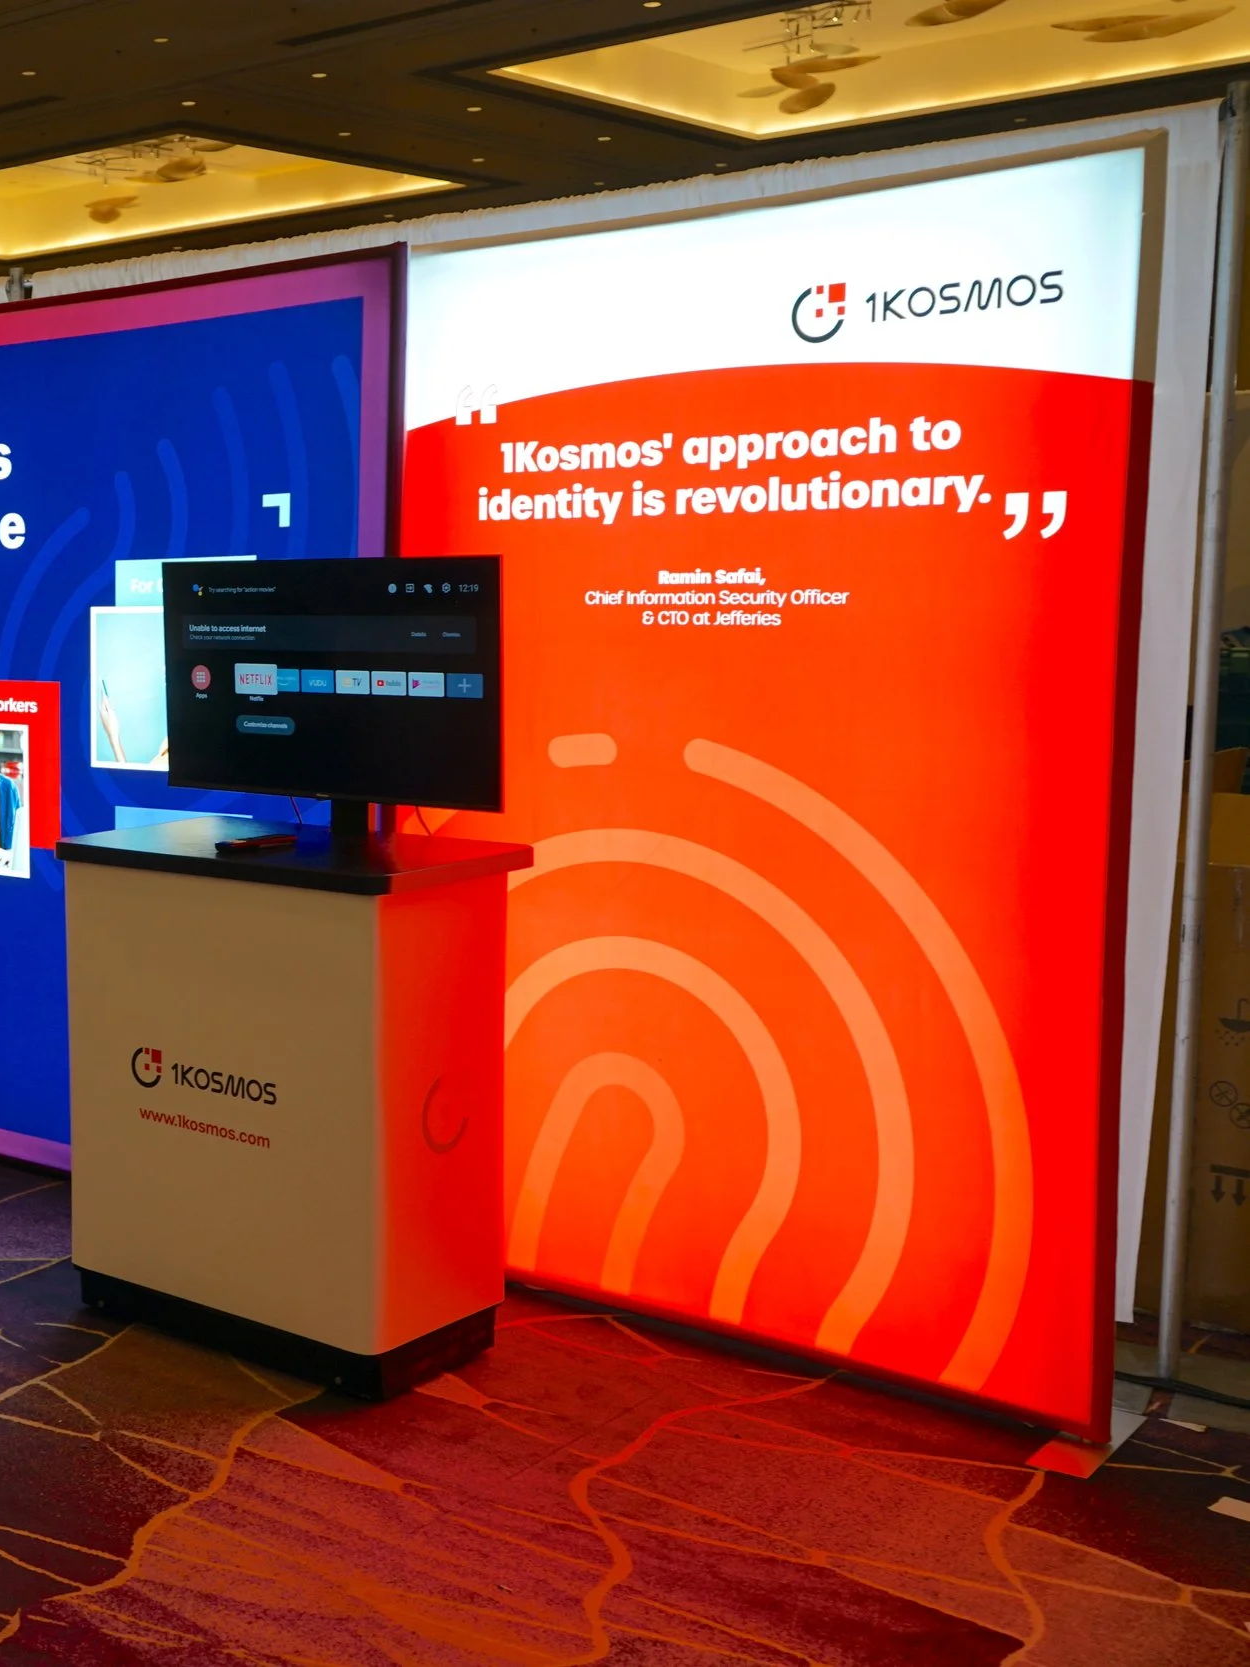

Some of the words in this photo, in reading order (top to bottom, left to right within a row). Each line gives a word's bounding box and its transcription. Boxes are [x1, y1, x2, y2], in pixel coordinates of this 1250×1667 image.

[865, 270, 1063, 323] 1KOSMOS
[501, 432, 673, 473] 1Kosmos'
[682, 417, 897, 471] approach
[909, 416, 962, 451] to
[478, 482, 624, 525] identity
[632, 480, 666, 516] is
[675, 470, 992, 515] revolutionary.
[130, 578, 155, 593] For
[658, 569, 712, 585] Ramin
[714, 568, 766, 586] Safai,
[458, 583, 479, 593] 12:19
[584, 590, 626, 605] Chief
[626, 590, 716, 605] Information
[719, 590, 787, 608] Security
[790, 589, 850, 605] Officer
[641, 610, 654, 625] &
[657, 611, 689, 625] CTO
[692, 612, 711, 625] at
[713, 611, 782, 626] Jefferies
[189, 624, 210, 632] Unable
[218, 625, 240, 633] access
[239, 673, 273, 686] NETFLIX
[171, 1063, 277, 1105] 1KOSMOS
[139, 1107, 271, 1149] www.1kosmos.com
